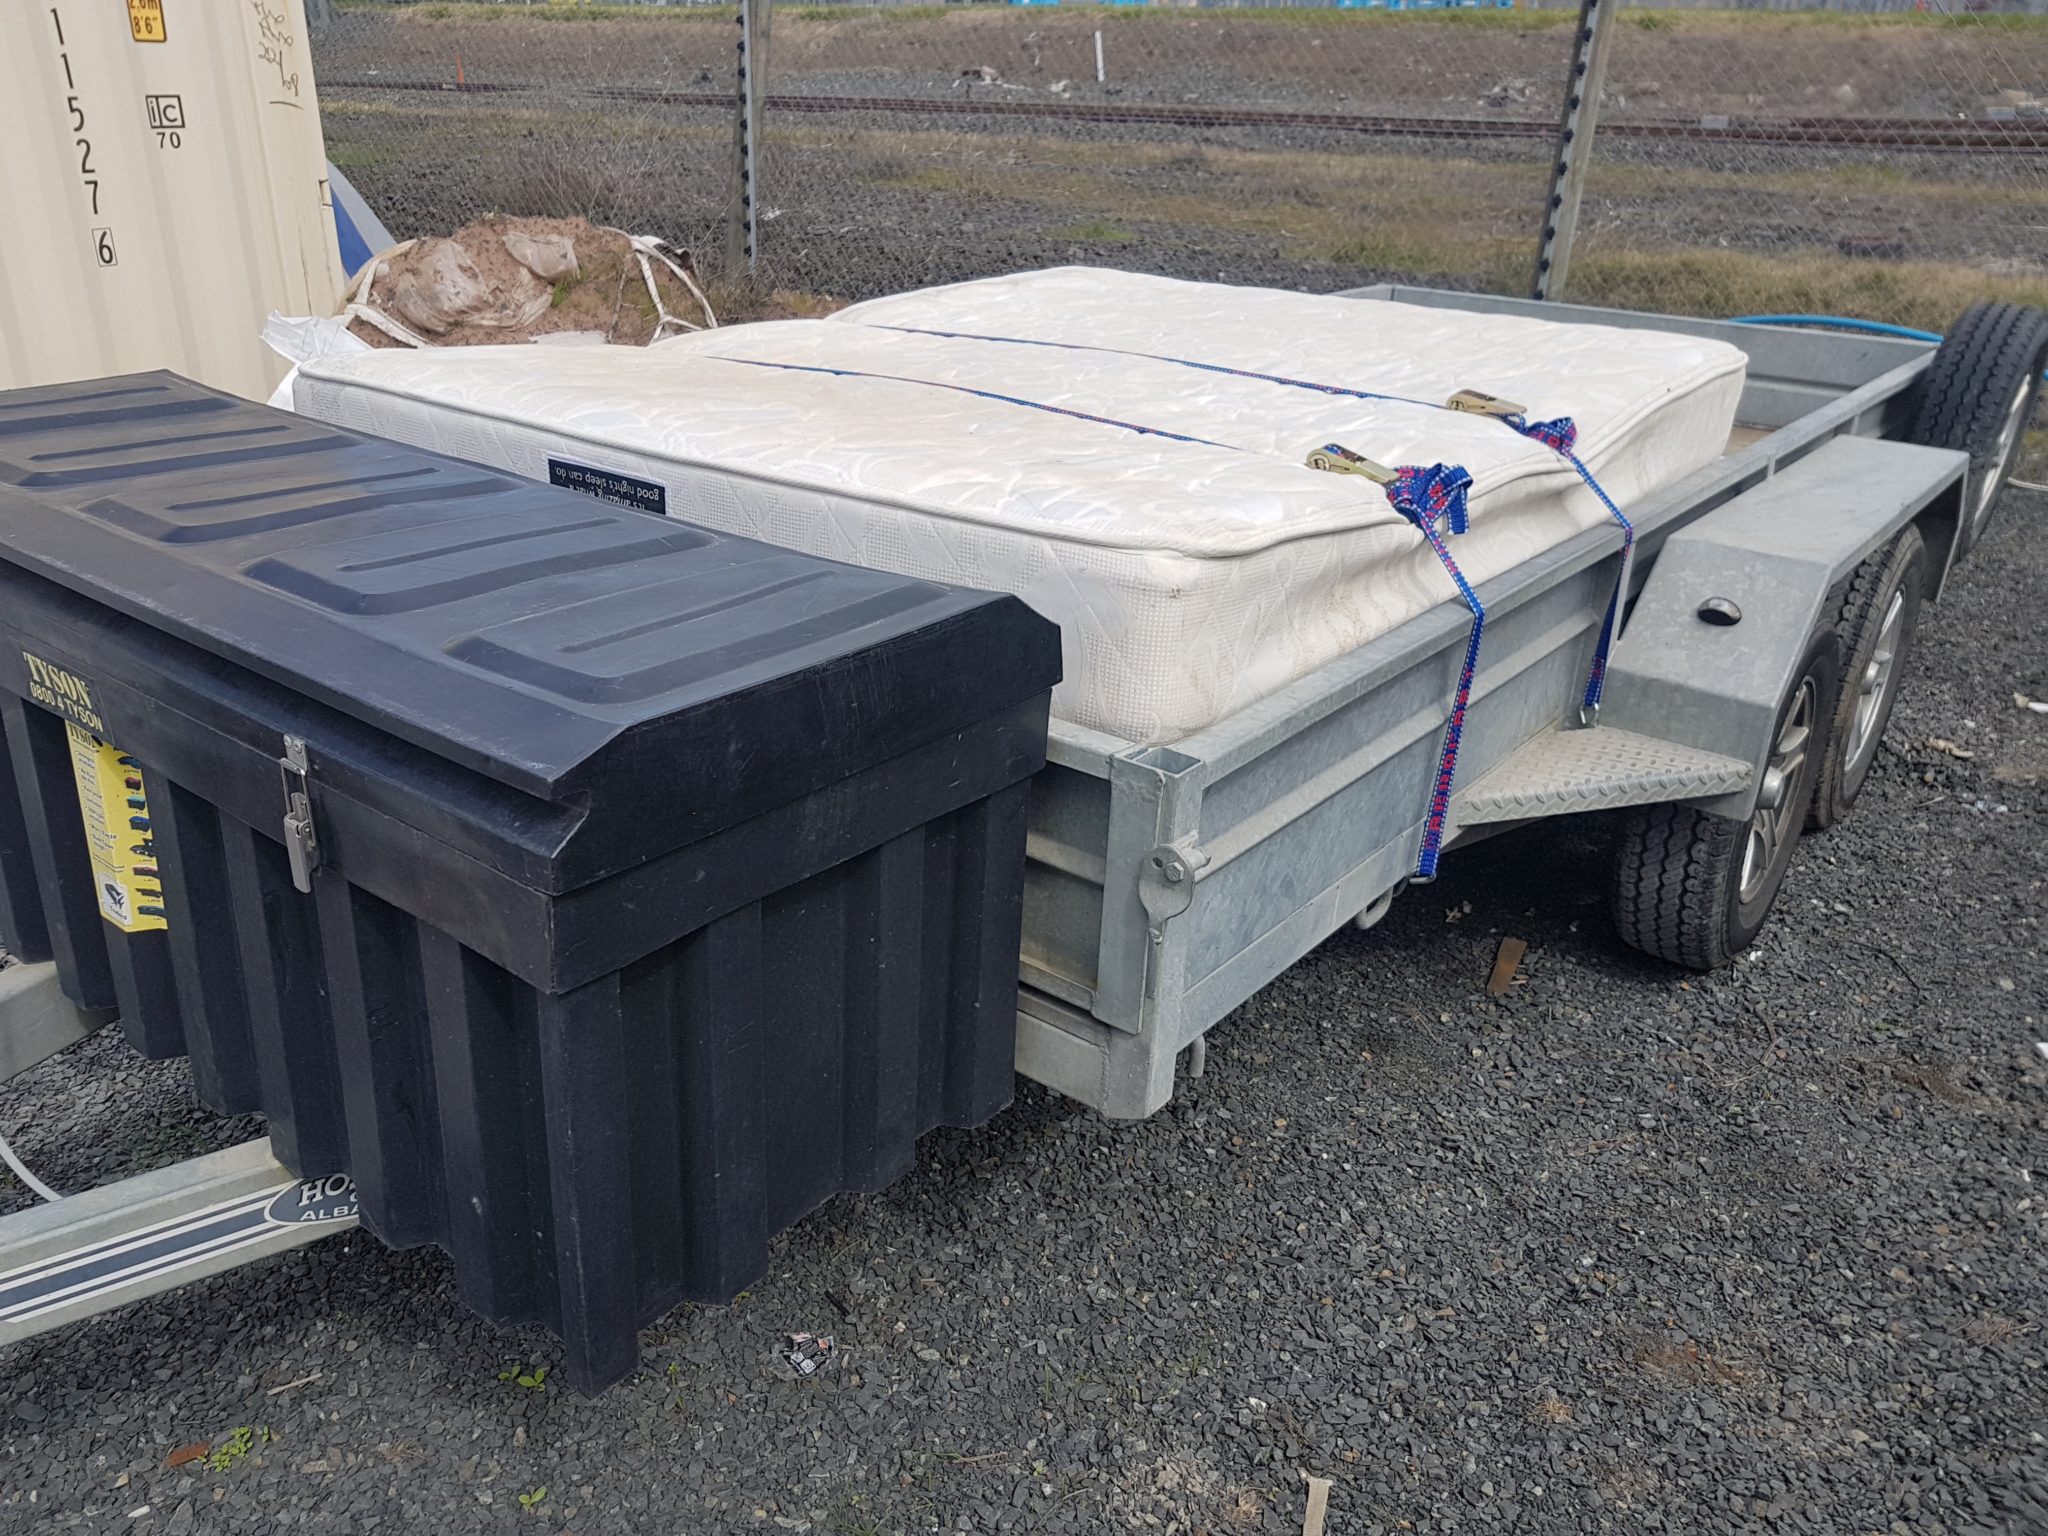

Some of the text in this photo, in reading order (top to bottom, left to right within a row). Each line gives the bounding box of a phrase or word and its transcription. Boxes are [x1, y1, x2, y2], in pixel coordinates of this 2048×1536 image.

[156, 131, 181, 149] 70
[569, 470, 583, 481] can
[585, 471, 607, 489] sleep
[609, 481, 635, 495] night's
[636, 487, 660, 501] good
[22, 651, 93, 709] TYSON
[30, 681, 104, 733] 0800 4 TYSON
[298, 1172, 356, 1207] HO
